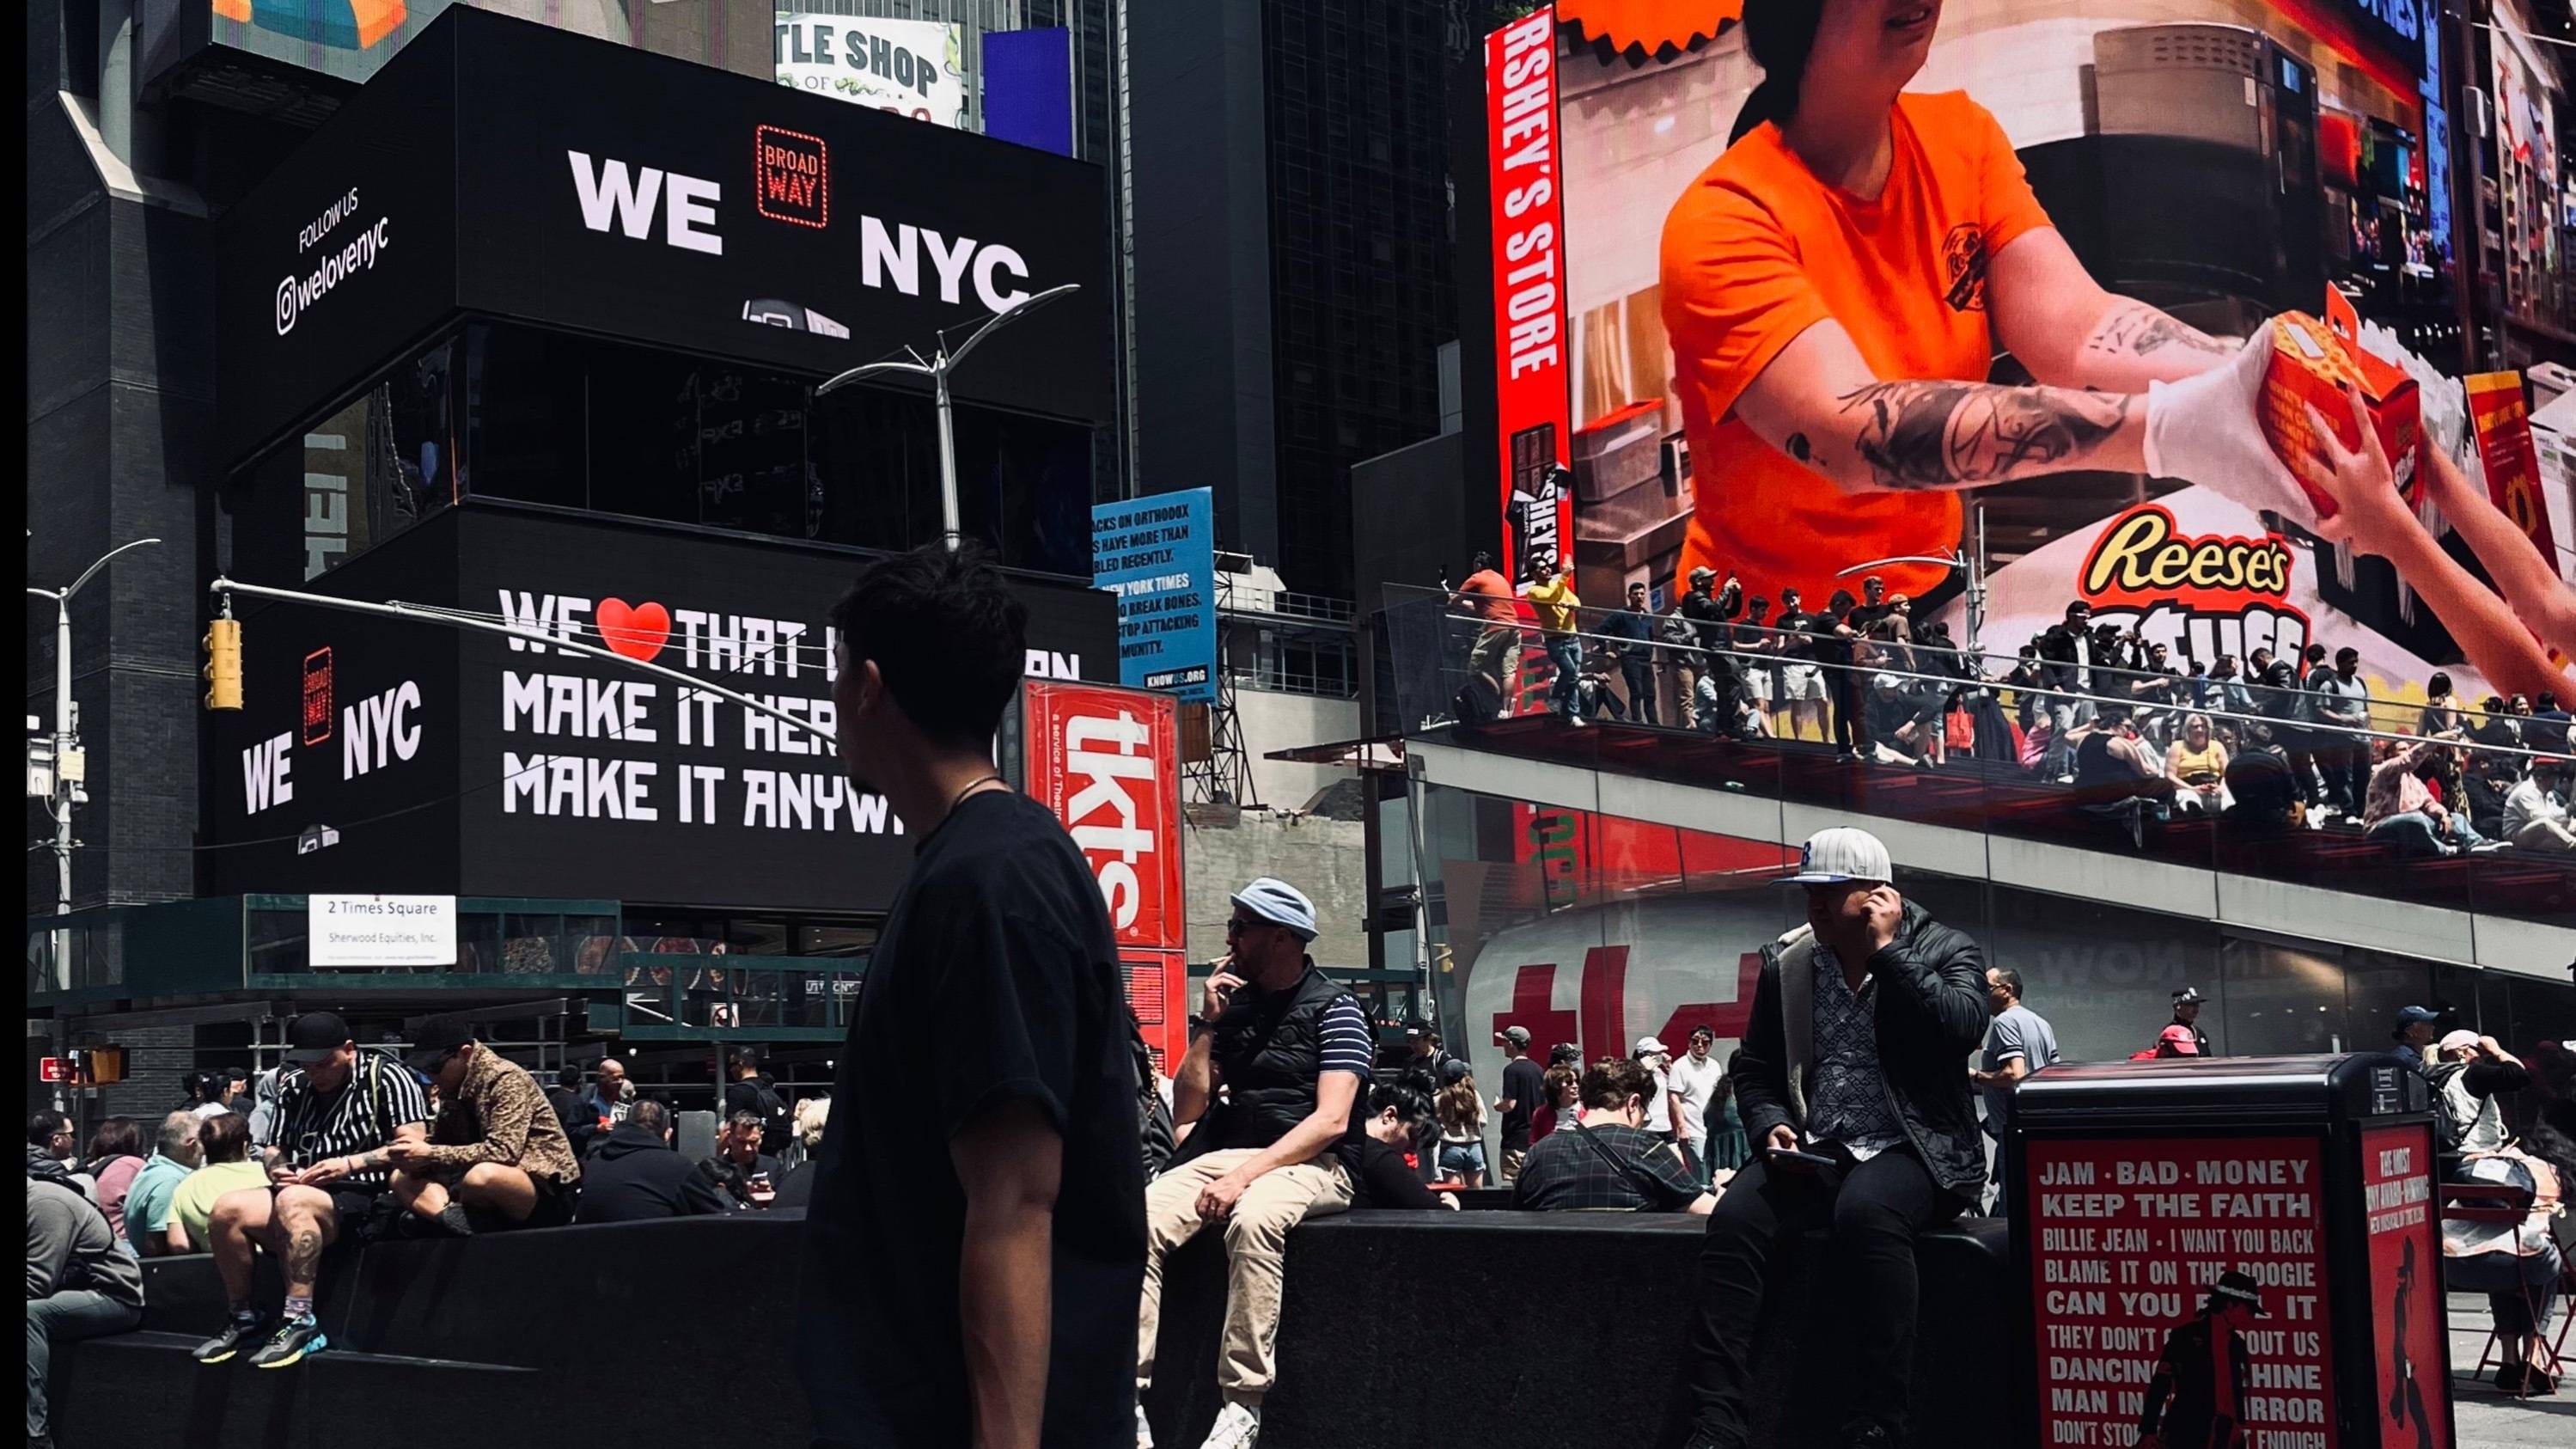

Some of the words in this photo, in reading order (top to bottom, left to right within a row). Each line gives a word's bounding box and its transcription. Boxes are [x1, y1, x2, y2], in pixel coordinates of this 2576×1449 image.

[845, 30, 938, 99] SHOP
[804, 76, 830, 89] OF
[766, 144, 818, 175] BROAD
[766, 167, 817, 207] WAY
[567, 150, 723, 256] WE
[300, 200, 341, 254] FOLLOW
[344, 186, 357, 217] US
[297, 217, 388, 310] welovenyc
[861, 214, 1029, 315] NYC
[1506, 222, 1558, 381] STORE
[1118, 514, 1132, 529] ON
[1135, 504, 1189, 526] ORTHODOX
[1102, 535, 1128, 553] HAVE
[1130, 530, 1159, 547] MORE
[1161, 525, 1189, 541] THAN
[2090, 514, 2287, 592] Reese's
[1121, 549, 1175, 570] RECENTLY.
[1126, 579, 1154, 596] YORK
[1129, 597, 1162, 615] BREAK
[1164, 592, 1202, 610] BONES.
[498, 589, 591, 658] WE
[675, 608, 807, 678] THAT
[1142, 614, 1199, 635] ATTACKING
[503, 669, 657, 743] MAKE
[678, 687, 724, 748] IT
[744, 693, 838, 757] HER
[1052, 713, 1060, 722] a
[344, 680, 422, 781] NYC
[1052, 724, 1062, 765] service
[242, 731, 293, 816] WE
[1053, 766, 1063, 780] of
[503, 752, 658, 822] MAKE
[679, 764, 725, 825] IT
[1066, 710, 1156, 930] tkts
[328, 901, 336, 914] 2
[341, 901, 383, 914] Times
[388, 902, 437, 918] Square
[329, 932, 377, 943] Sherwood
[2040, 1162, 2095, 1185] JAM
[2117, 1161, 2179, 1185] BAD
[2197, 1160, 2309, 1184] MONEY
[2042, 1194, 2125, 1217] KEEP
[2134, 1194, 2201, 1217] THE
[2211, 1194, 2311, 1217] FAITH
[2043, 1228, 2096, 1252] BILLIE
[2102, 1228, 2148, 1252] JEAN
[2170, 1229, 2176, 1252] I
[2181, 1229, 2226, 1253] WANT
[2232, 1229, 2265, 1254] YOU
[2271, 1229, 2315, 1254] BACK
[2045, 1259, 2111, 1284] BLAME
[2121, 1261, 2140, 1284] IT
[2150, 1261, 2177, 1285] ON
[2187, 1261, 2227, 1286] THE
[2047, 1291, 2106, 1315] CAN
[2120, 1293, 2182, 1318] YOU
[2286, 1296, 2317, 1320] IT
[2047, 1324, 2094, 1349] THEY
[2102, 1325, 2157, 1352] DON'T
[2293, 1332, 2320, 1357] US
[2051, 1388, 2108, 1415] MAN
[2118, 1391, 2145, 1417] IN
[2053, 1419, 2097, 1447] DON'T
[2256, 1429, 2326, 1449] ENOUGH
